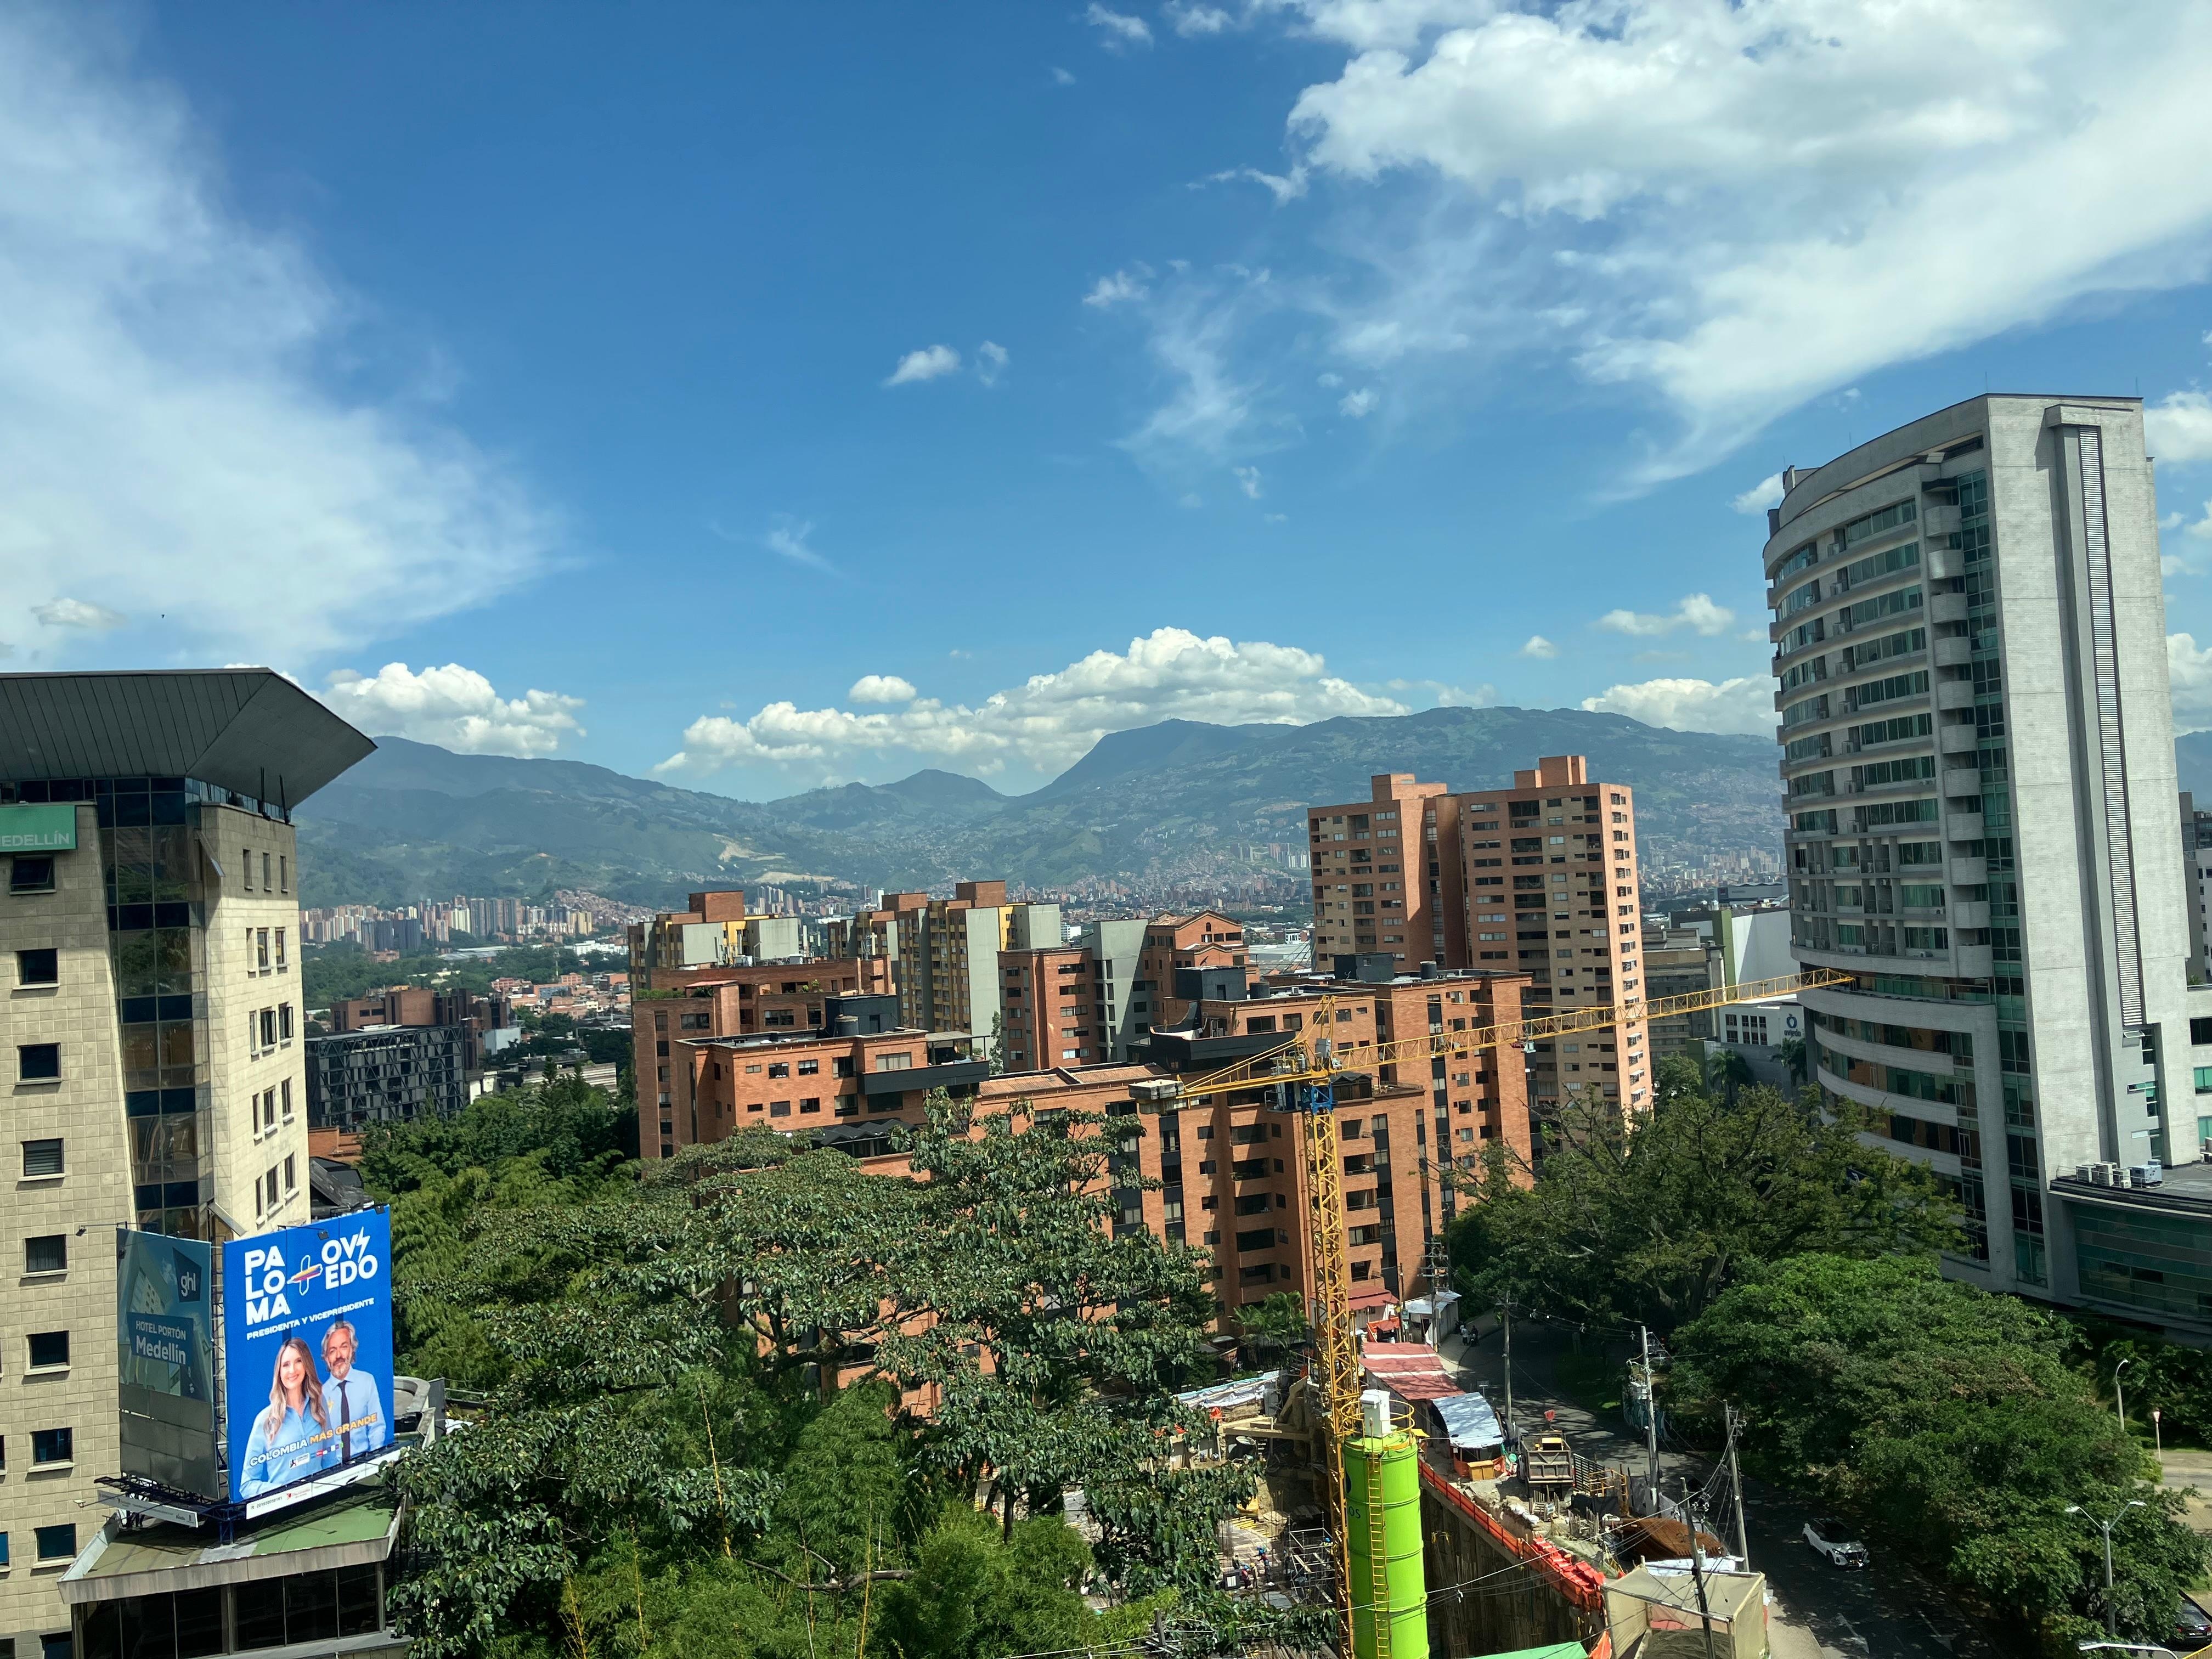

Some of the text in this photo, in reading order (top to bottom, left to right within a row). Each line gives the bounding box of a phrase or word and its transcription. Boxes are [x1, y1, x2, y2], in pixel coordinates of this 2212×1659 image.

[0, 831, 70, 847] EDELLÍN
[180, 1271, 196, 1297] ghl
[136, 1320, 186, 1341] HOTEL PORTÓN
[246, 1319, 301, 1340] PRESIDENTA
[309, 1297, 375, 1322] VICEPRESIDENTE
[137, 1335, 186, 1365] Medellín
[250, 1438, 308, 1467] COLOMBIA
[335, 1412, 377, 1435] GRANDE
